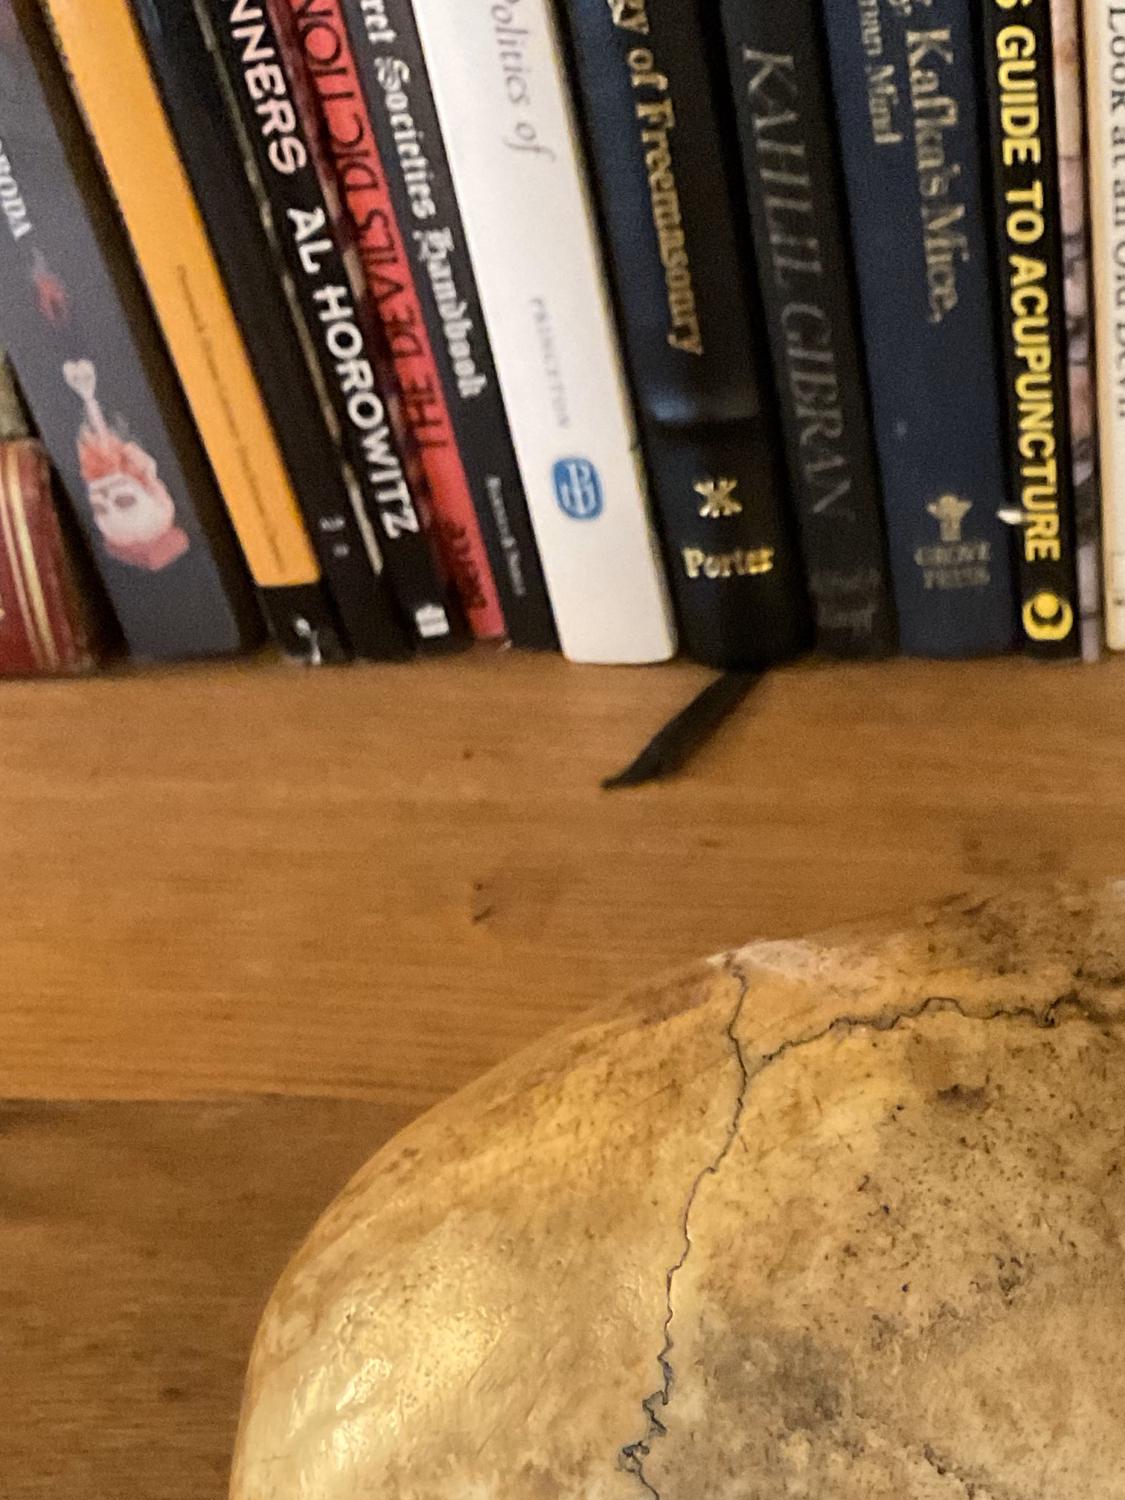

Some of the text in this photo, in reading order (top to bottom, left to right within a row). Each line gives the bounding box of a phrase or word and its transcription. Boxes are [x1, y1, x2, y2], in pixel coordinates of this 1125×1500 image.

[490, 0, 557, 163] olitics of
[626, 47, 669, 91] of
[995, 24, 1041, 167] GUIDE
[373, 56, 437, 219] Societies
[412, 226, 488, 399] Handbook
[635, 97, 703, 355] Freemasonry
[1004, 180, 1044, 246] TO
[286, 207, 333, 274] AL
[312, 285, 420, 539] HOROWITZ
[778, 302, 856, 518] GIBRAN
[1009, 256, 1060, 563] ACUPUNCTURE
